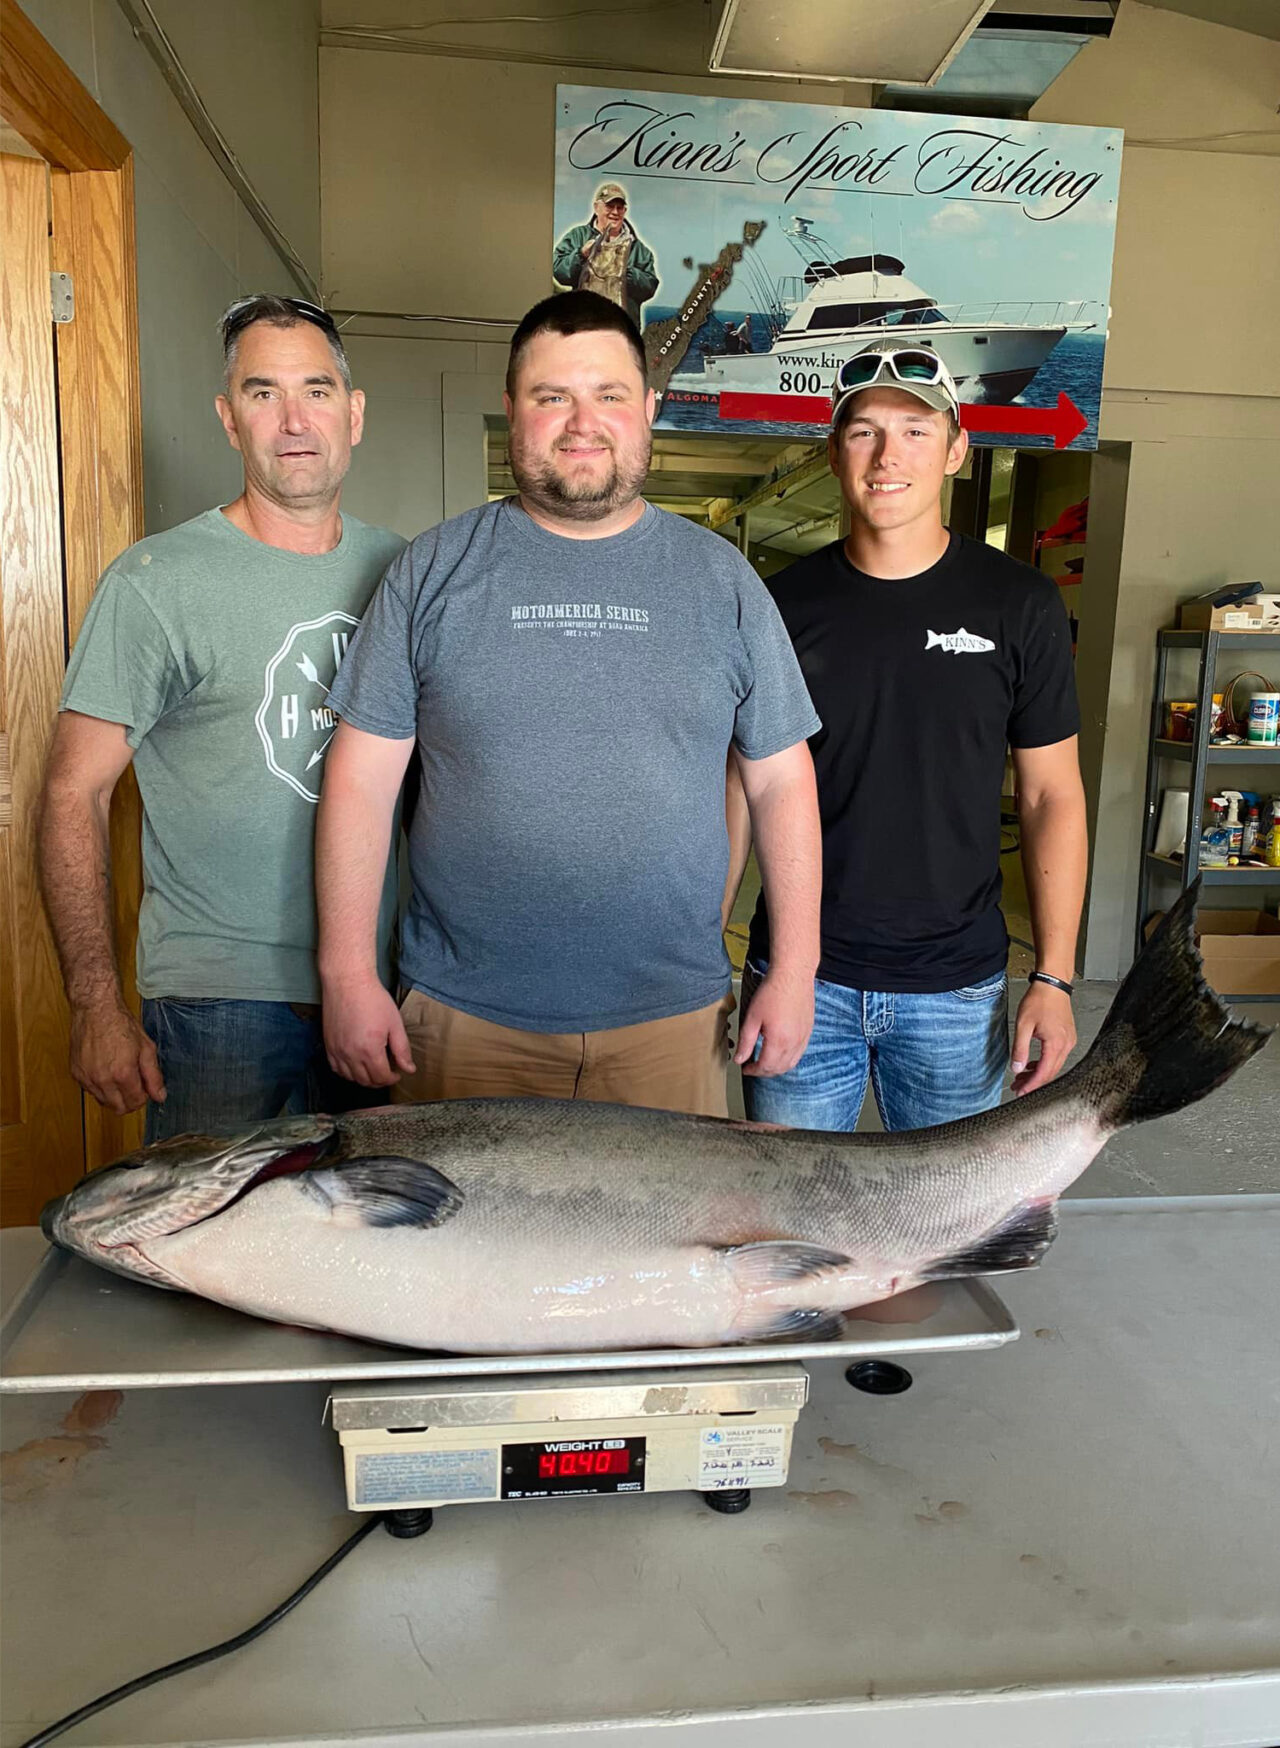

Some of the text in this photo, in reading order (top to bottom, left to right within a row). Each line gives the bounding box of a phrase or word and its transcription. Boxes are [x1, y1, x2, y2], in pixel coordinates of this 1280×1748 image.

[569, 101, 1103, 221] Kinn's Sport Fishing
[659, 279, 712, 355] DOOR COUNTY
[779, 371, 833, 393] 800-
[667, 392, 718, 403] ALGOMA
[511, 604, 649, 623] MOTOAMERICA SERIES
[945, 637, 986, 650] KINN'S
[281, 694, 299, 739] H
[544, 1441, 602, 1453] WEIGHT
